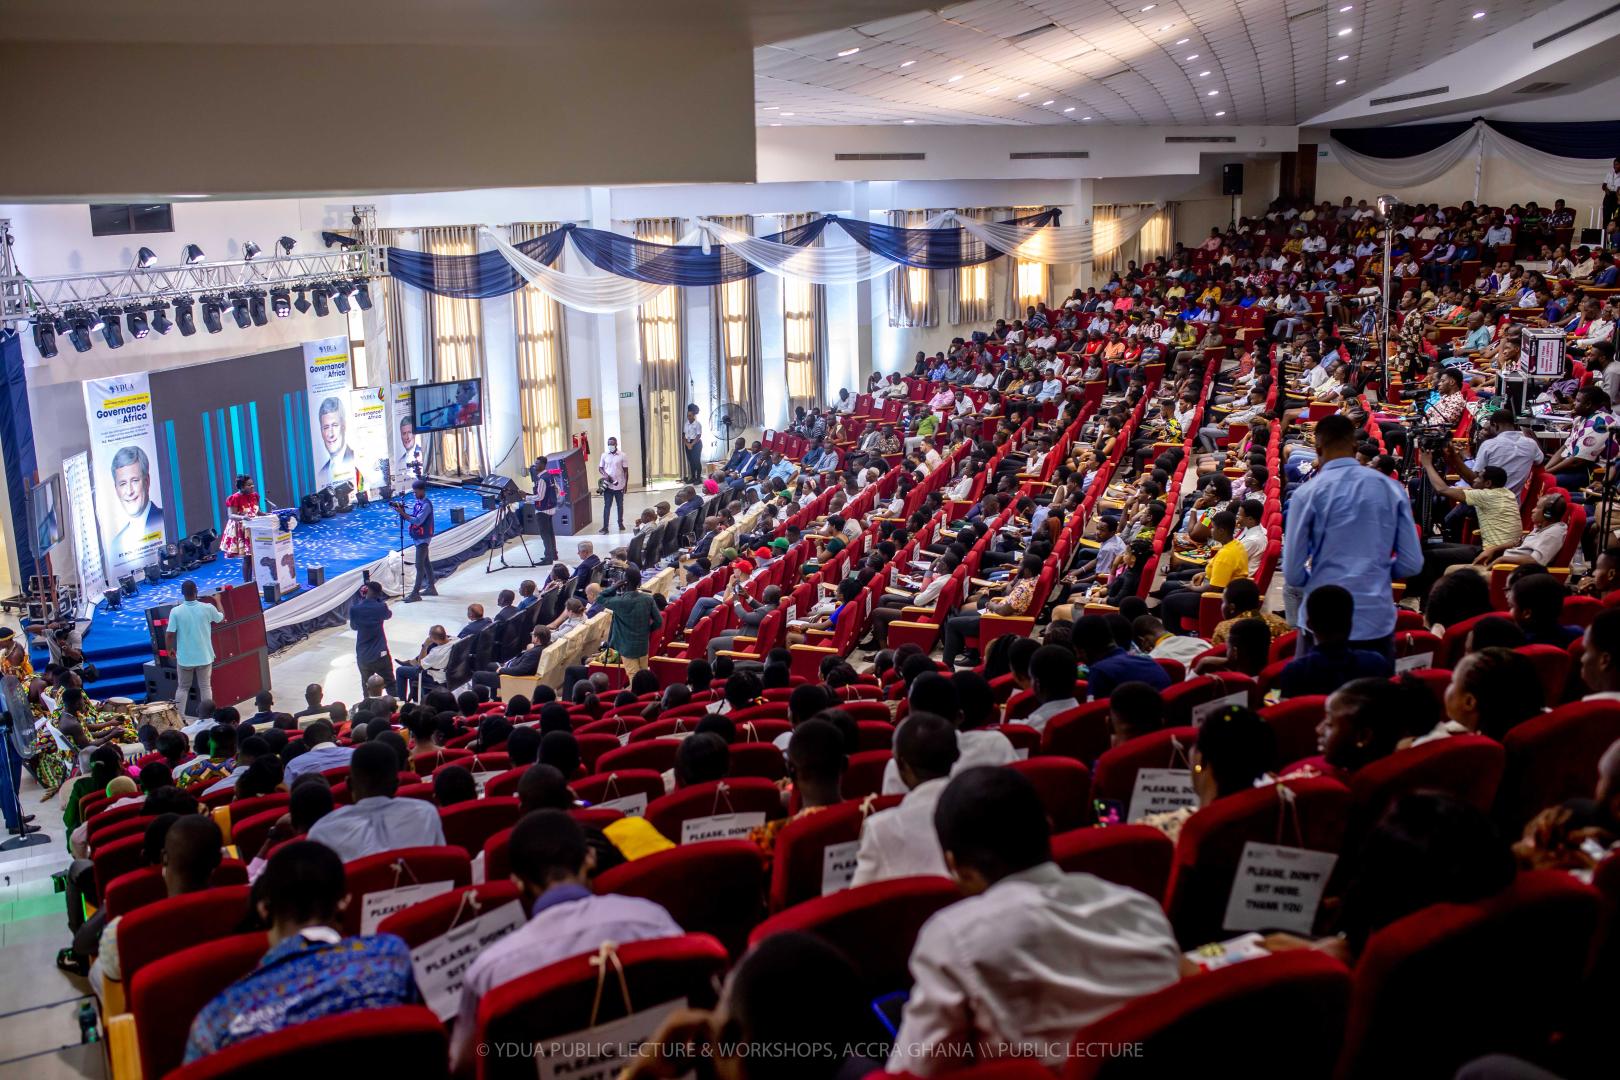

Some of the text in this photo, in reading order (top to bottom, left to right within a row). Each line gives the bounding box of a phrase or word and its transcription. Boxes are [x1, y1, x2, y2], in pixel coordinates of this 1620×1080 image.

[310, 363, 345, 373] Governance
[328, 370, 346, 378] Africa
[97, 404, 146, 419] Governance
[123, 413, 147, 423] Africa
[1245, 899, 1279, 911] THANK
